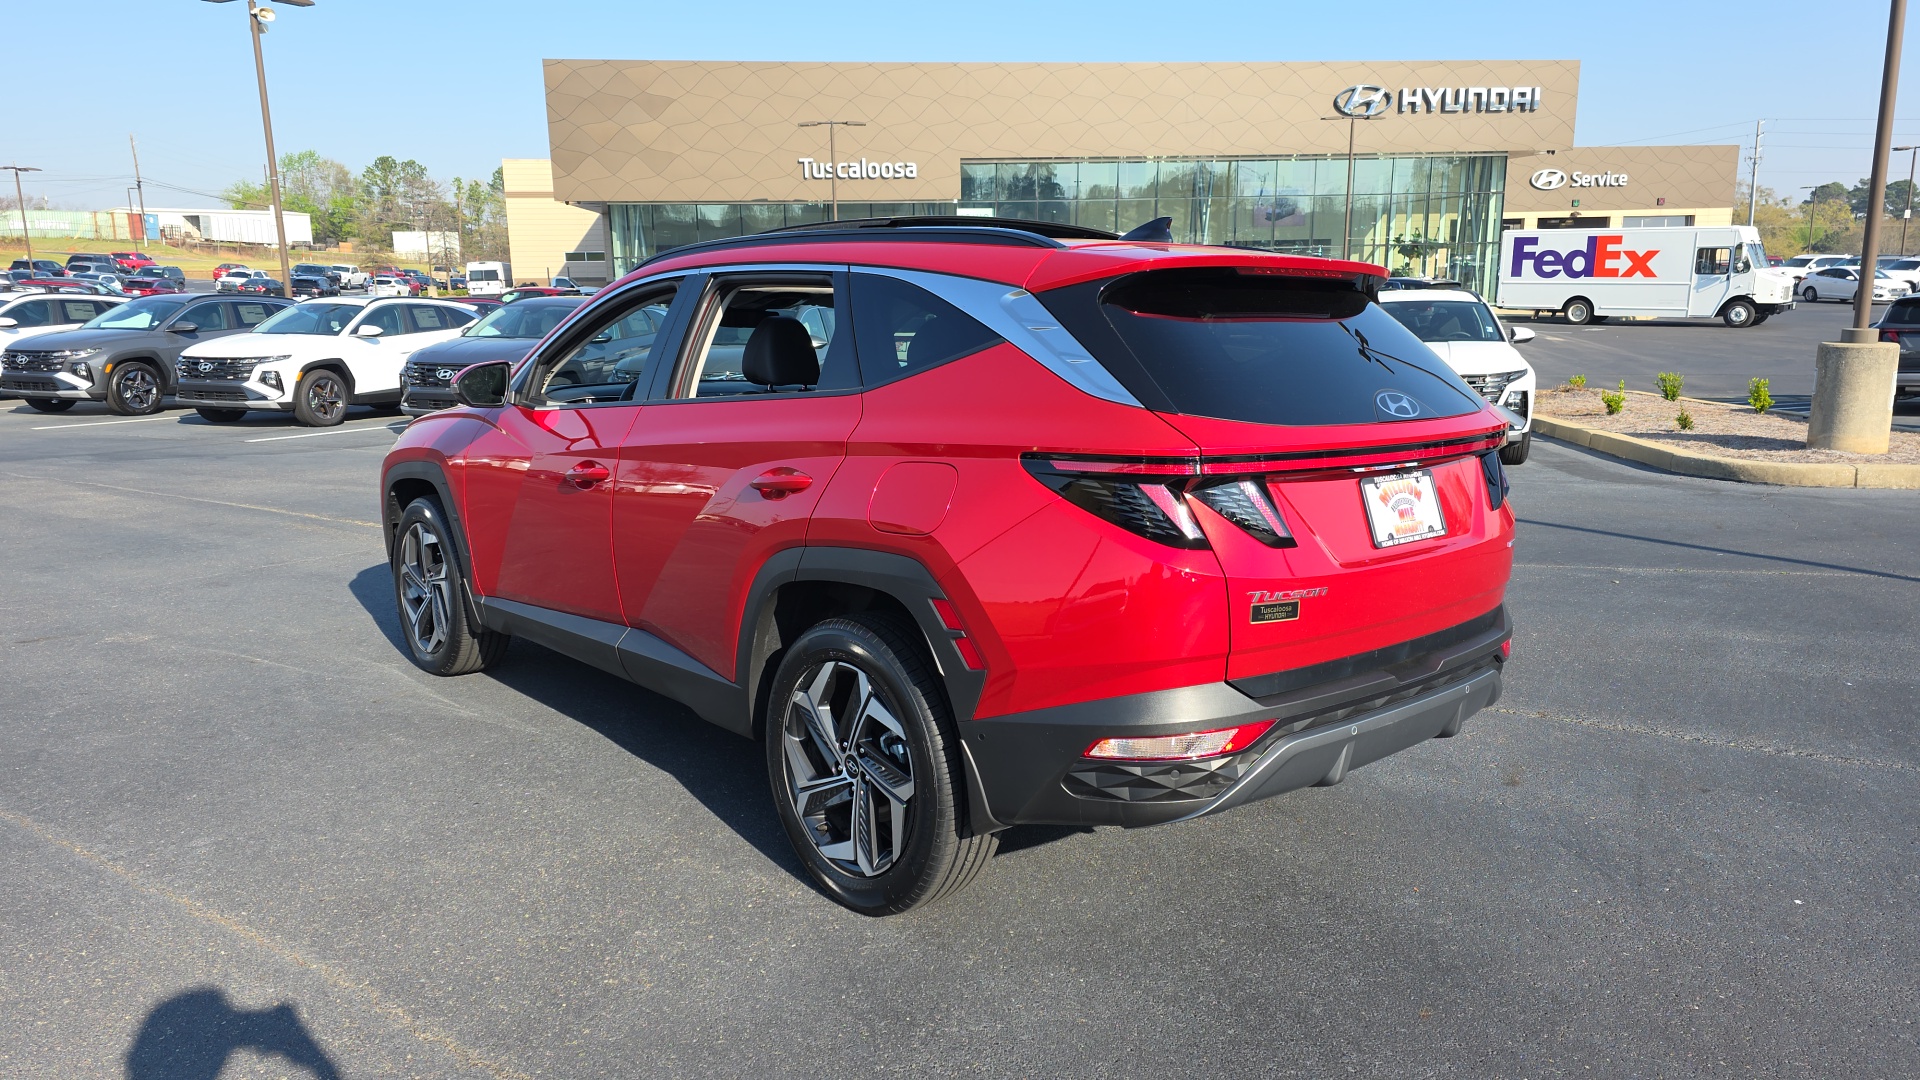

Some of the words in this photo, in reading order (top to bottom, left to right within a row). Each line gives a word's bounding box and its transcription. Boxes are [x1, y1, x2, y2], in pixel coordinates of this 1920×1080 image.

[1398, 86, 1541, 114] HYUNDAI
[798, 157, 918, 179] Tuscaloosa
[1570, 170, 1629, 187] Service
[1510, 235, 1661, 279] FedEx
[1378, 480, 1422, 508] MILLION
[1397, 507, 1416, 520] MILE
[1393, 520, 1425, 536] WARRANTY
[1260, 605, 1292, 613] Tuscaloosa
[1264, 612, 1287, 620] HYUNDAI
